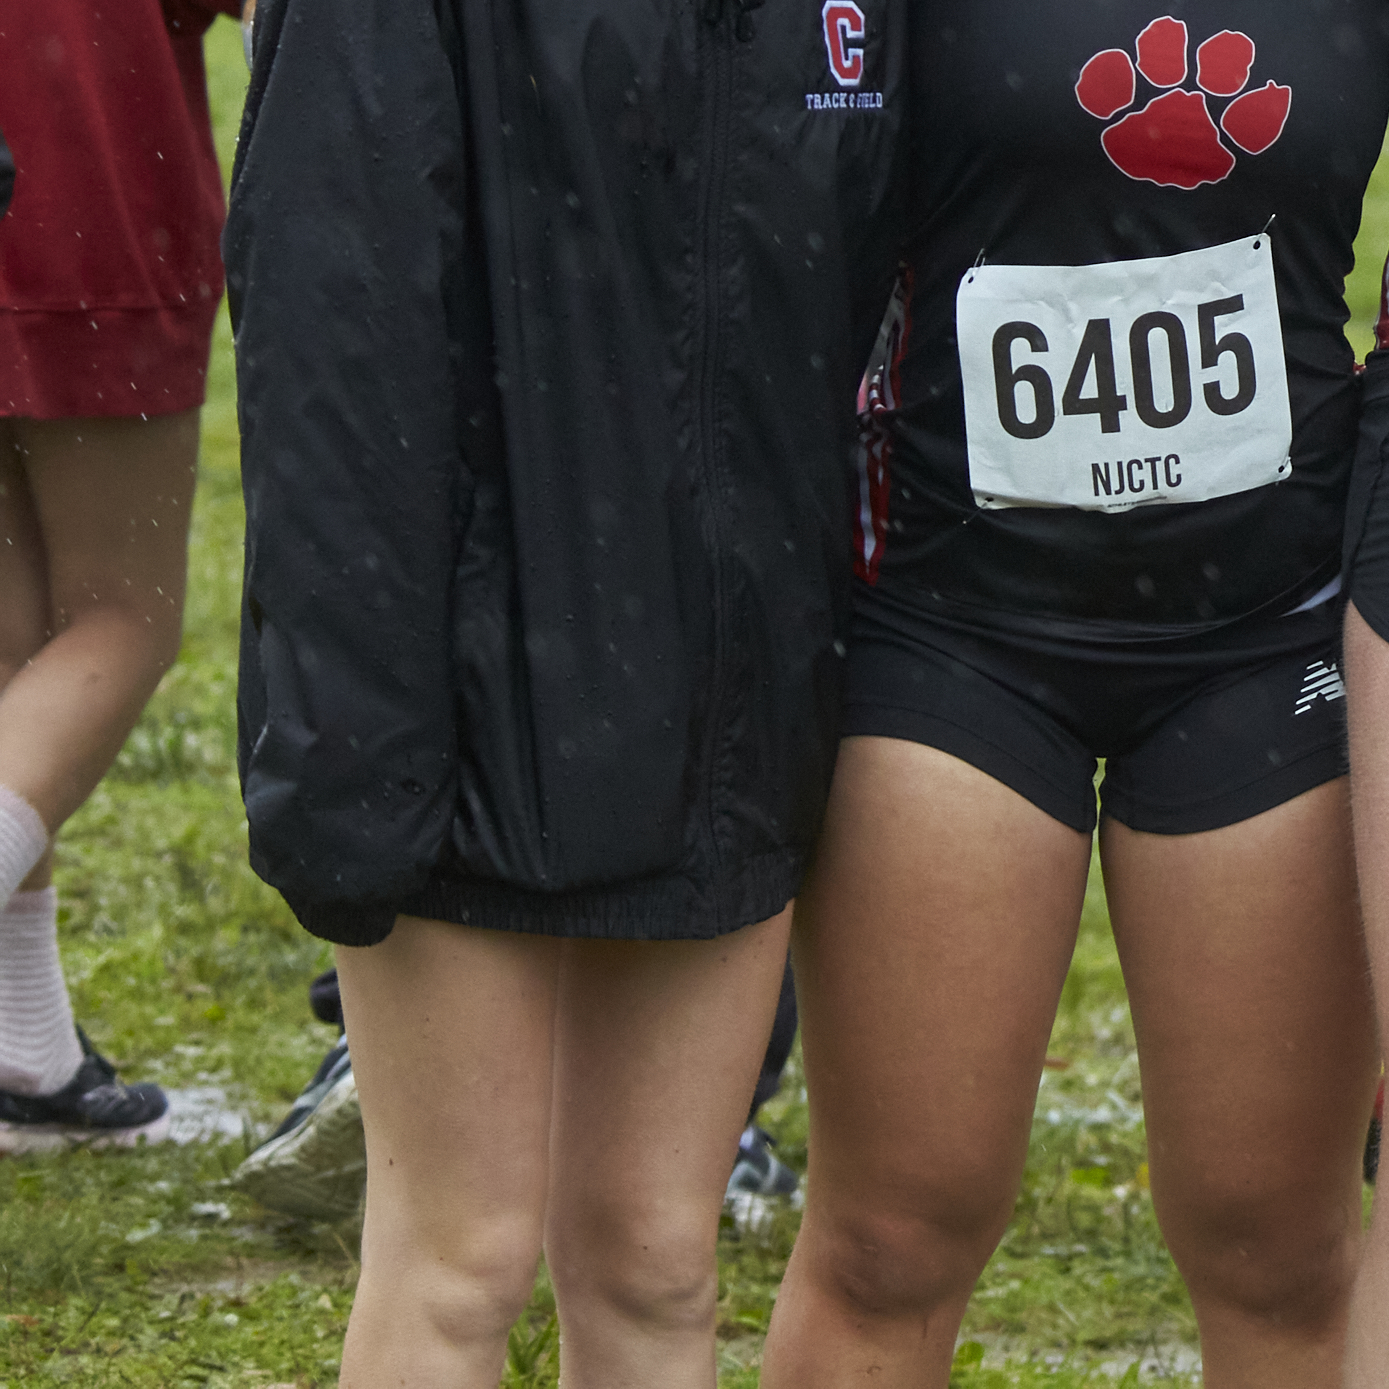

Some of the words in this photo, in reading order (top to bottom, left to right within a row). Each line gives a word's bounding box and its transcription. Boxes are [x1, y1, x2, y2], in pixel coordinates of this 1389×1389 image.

[822, 0, 865, 86] C
[805, 92, 847, 110] TRACK
[992, 293, 1257, 440] 6405
[1091, 454, 1183, 497] NJCTC
